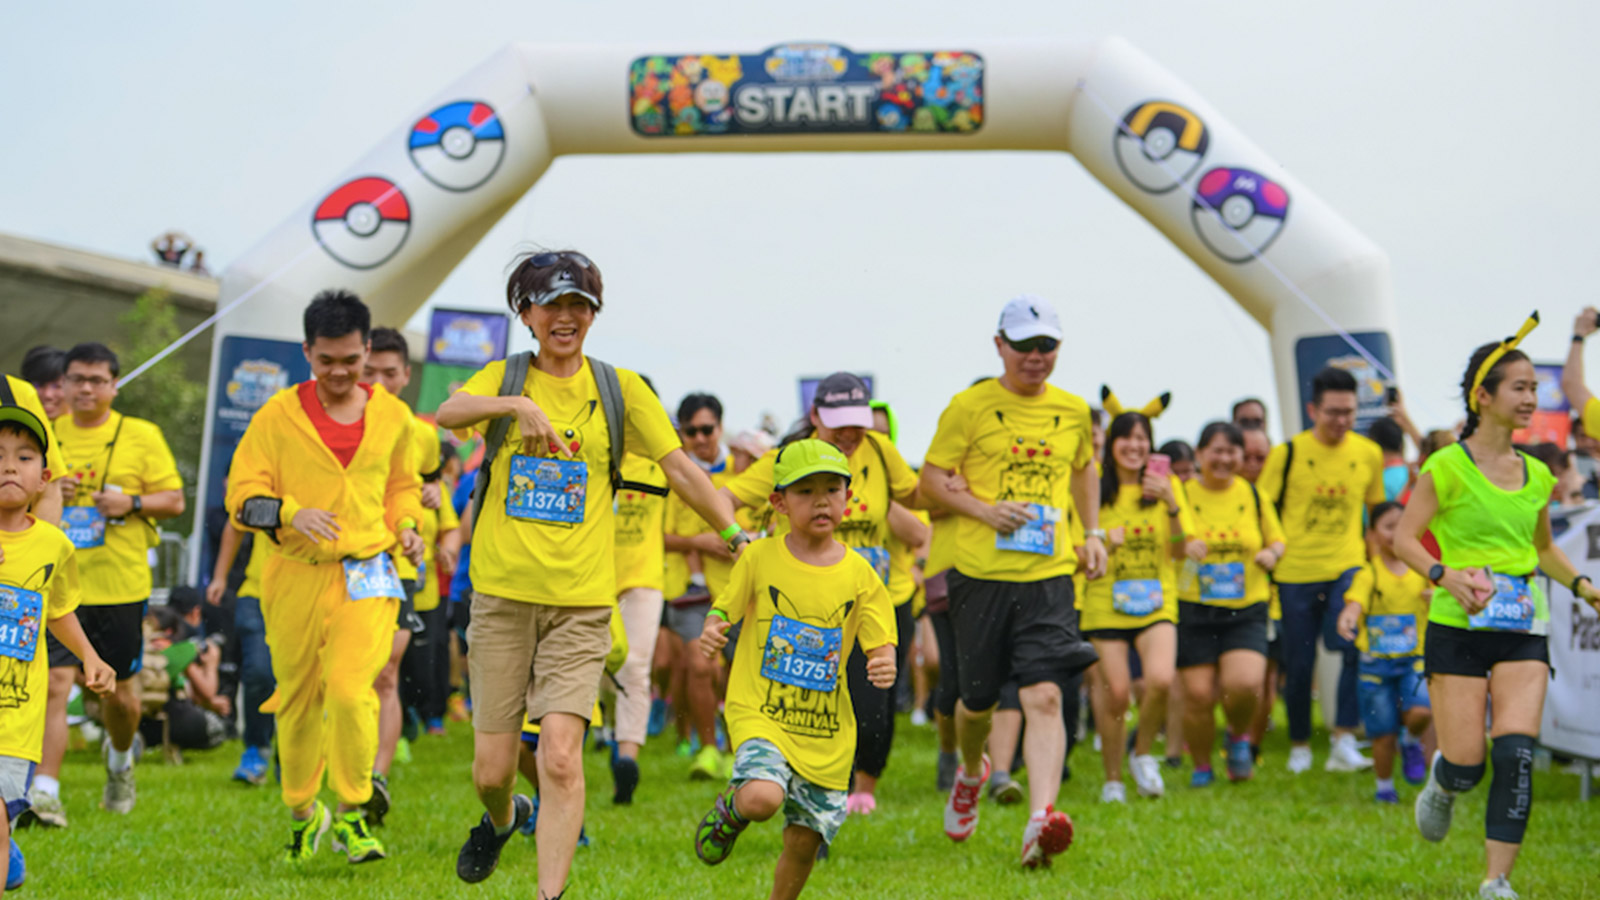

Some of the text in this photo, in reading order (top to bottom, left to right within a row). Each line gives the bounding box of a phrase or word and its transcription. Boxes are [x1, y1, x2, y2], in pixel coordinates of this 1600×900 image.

[739, 86, 874, 123] START
[526, 491, 567, 511] 1374
[783, 656, 826, 680] 1375
[760, 704, 839, 732] CARNIVAL
[1507, 747, 1532, 819] Kalenji
